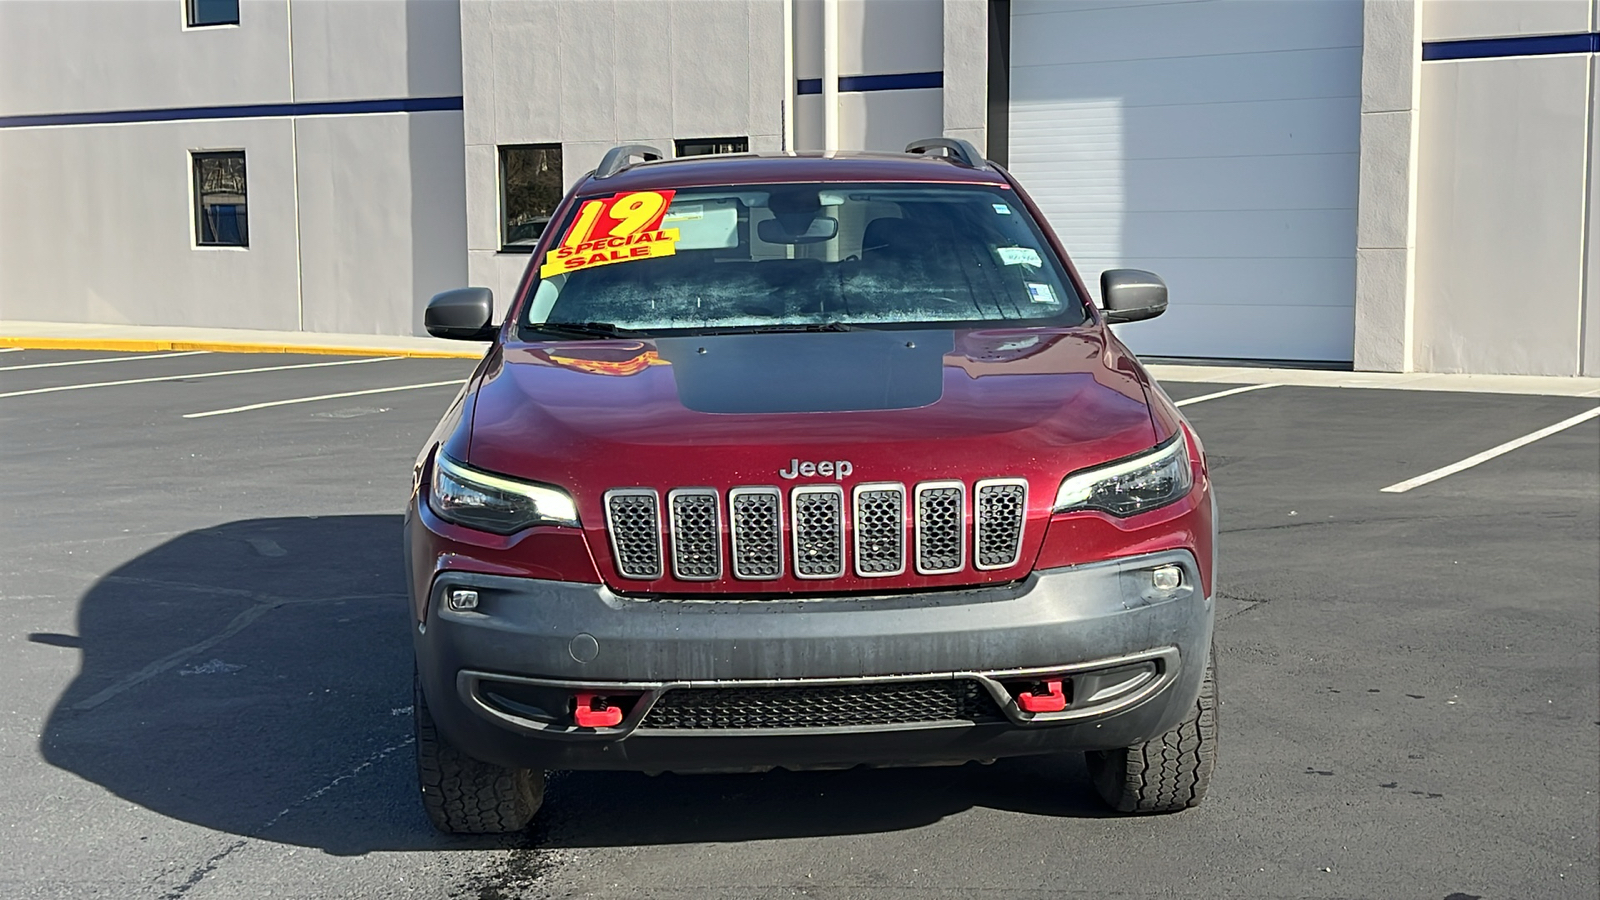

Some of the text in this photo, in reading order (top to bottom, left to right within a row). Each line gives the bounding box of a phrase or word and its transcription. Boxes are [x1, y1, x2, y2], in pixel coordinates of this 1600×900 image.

[564, 191, 666, 247] 19
[556, 231, 672, 259] SPECIAL
[564, 246, 650, 269] SALE
[779, 458, 853, 481] Jeep
